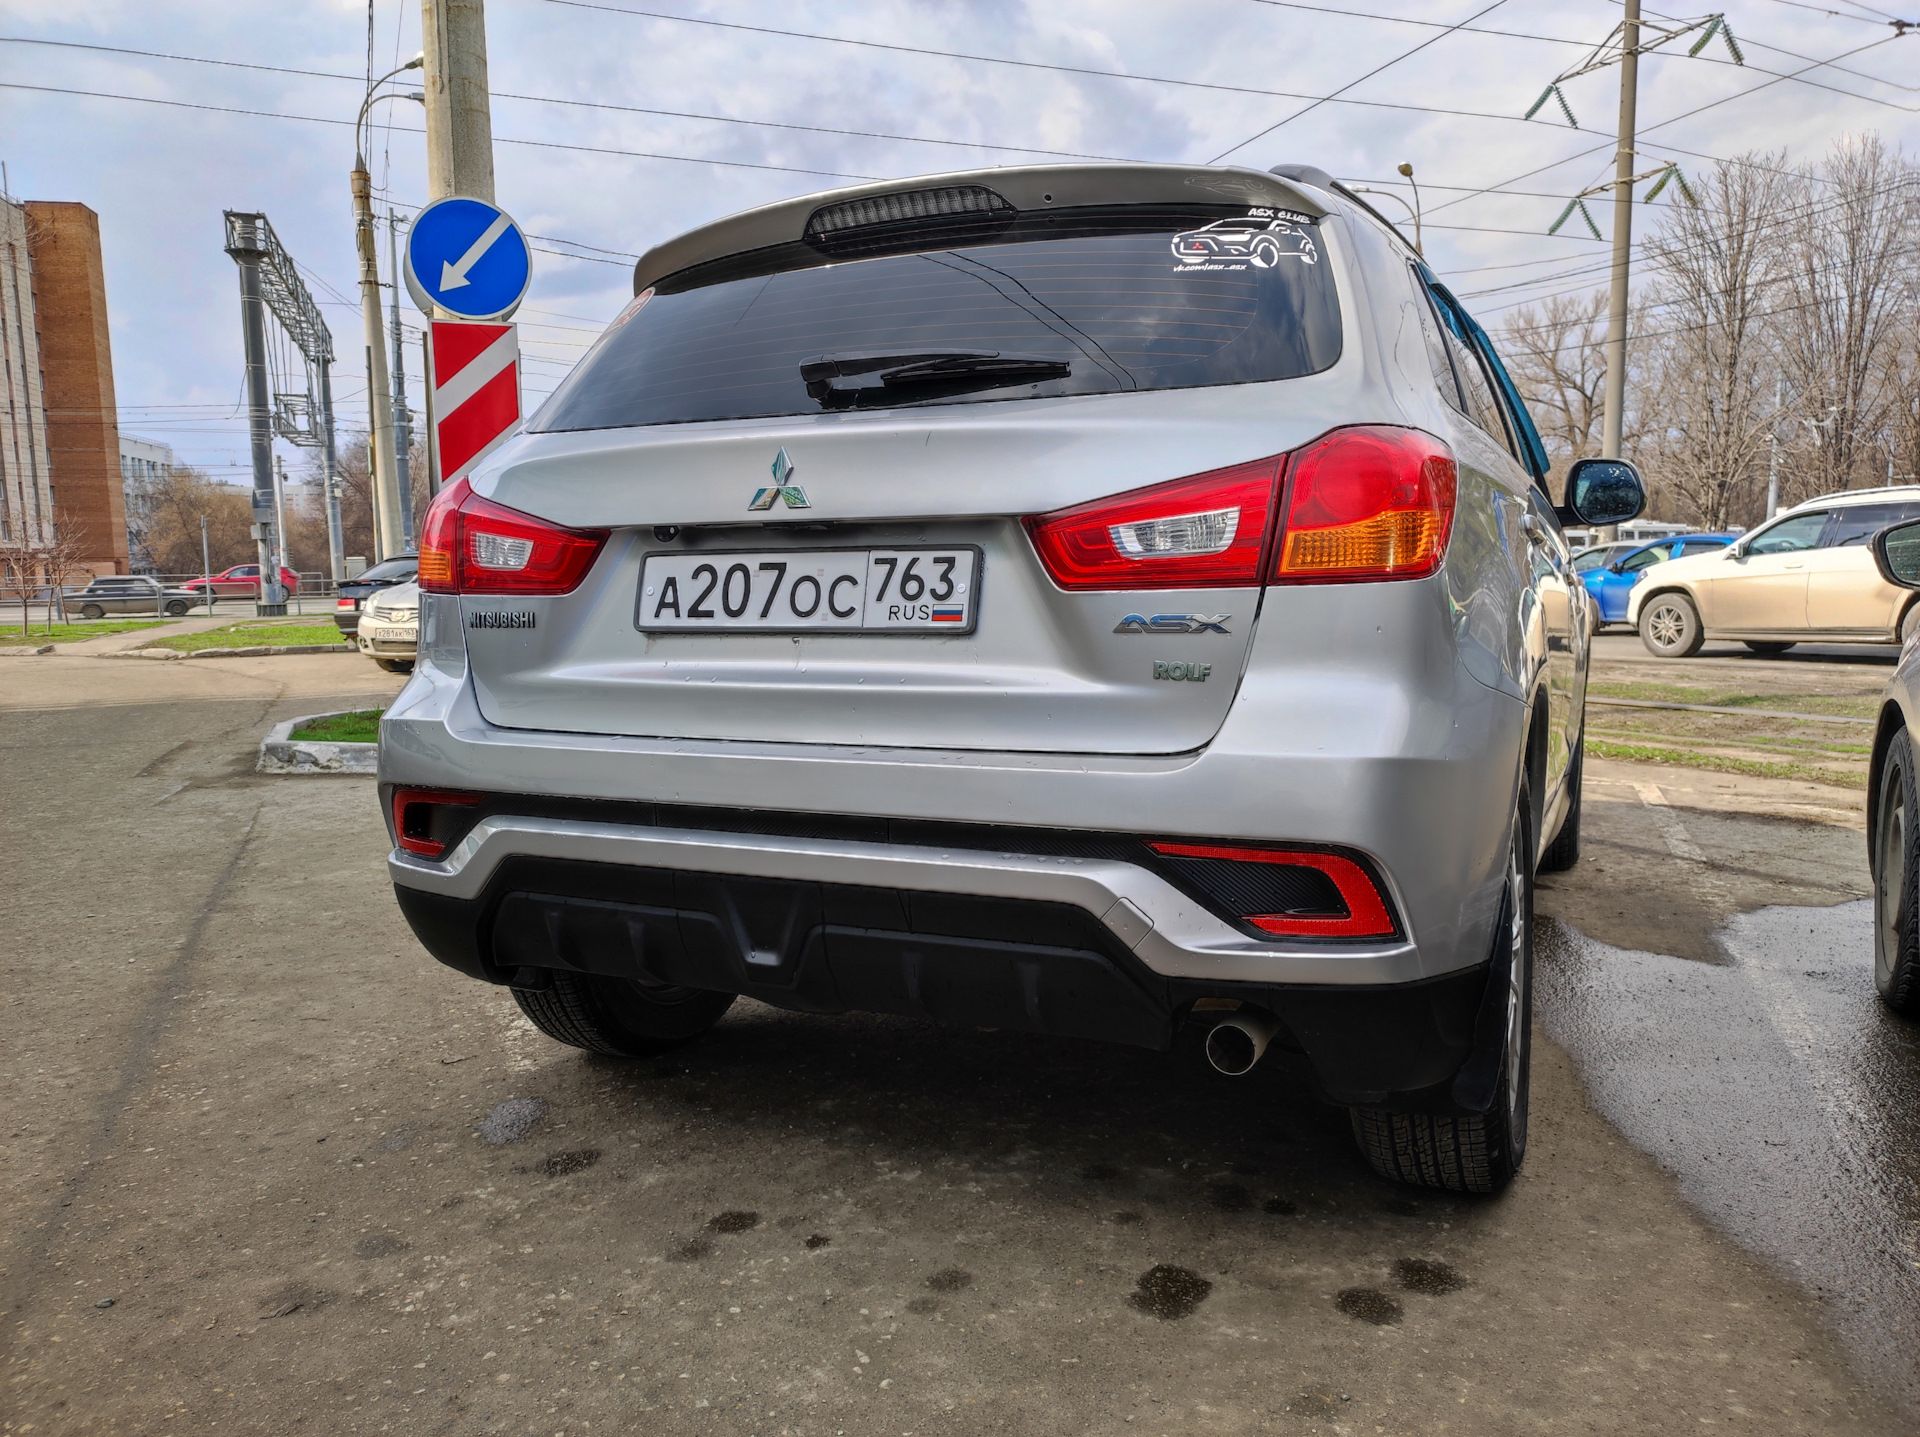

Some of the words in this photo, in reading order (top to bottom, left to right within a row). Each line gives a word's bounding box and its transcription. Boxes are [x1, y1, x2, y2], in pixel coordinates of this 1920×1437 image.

[1248, 207, 1275, 218] ASX
[1277, 210, 1311, 224] CLUB
[874, 557, 957, 602] 763
[468, 611, 536, 629] MITSUBISHI
[888, 604, 930, 621] RUS
[1112, 613, 1232, 634] ASX
[1153, 660, 1212, 682] ROLF
